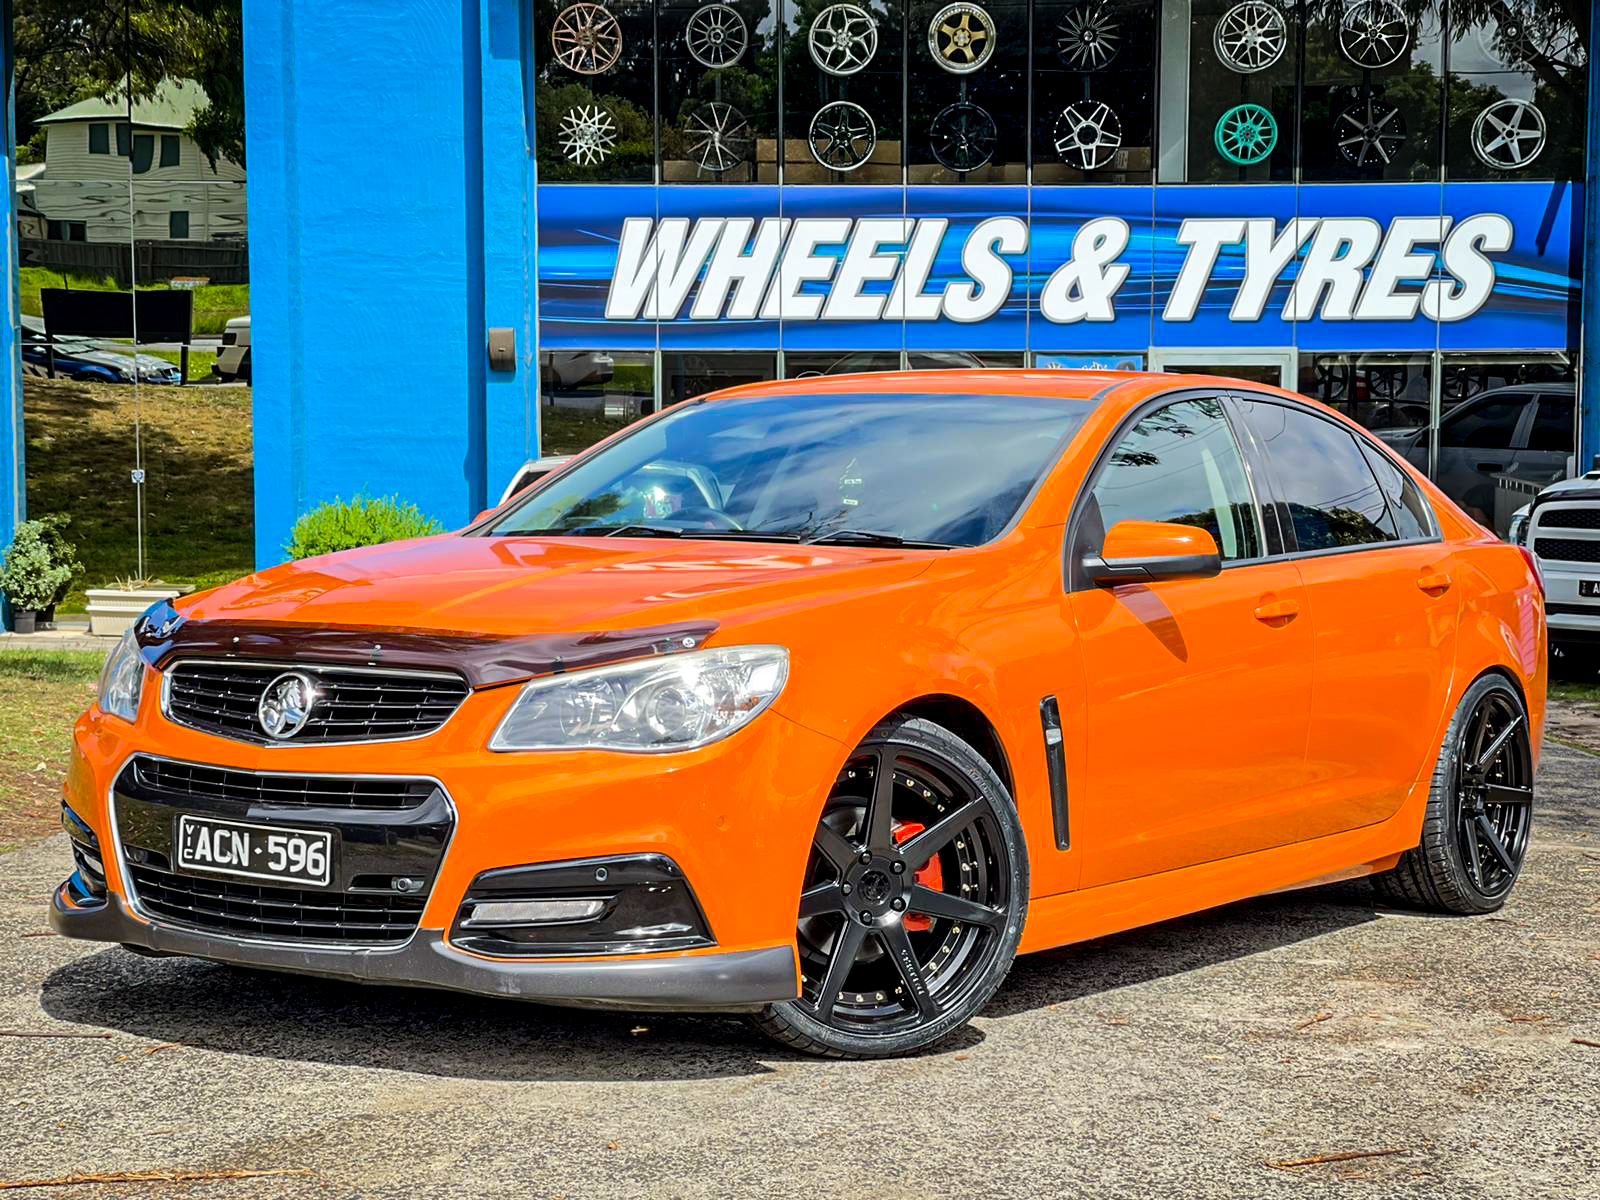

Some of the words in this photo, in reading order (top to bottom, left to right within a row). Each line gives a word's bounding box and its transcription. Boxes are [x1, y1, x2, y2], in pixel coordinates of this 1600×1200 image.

[605, 216, 1029, 323] WHEELS
[1040, 216, 1130, 323] &
[1162, 213, 1514, 322] TYRES
[183, 824, 195, 860] VIC
